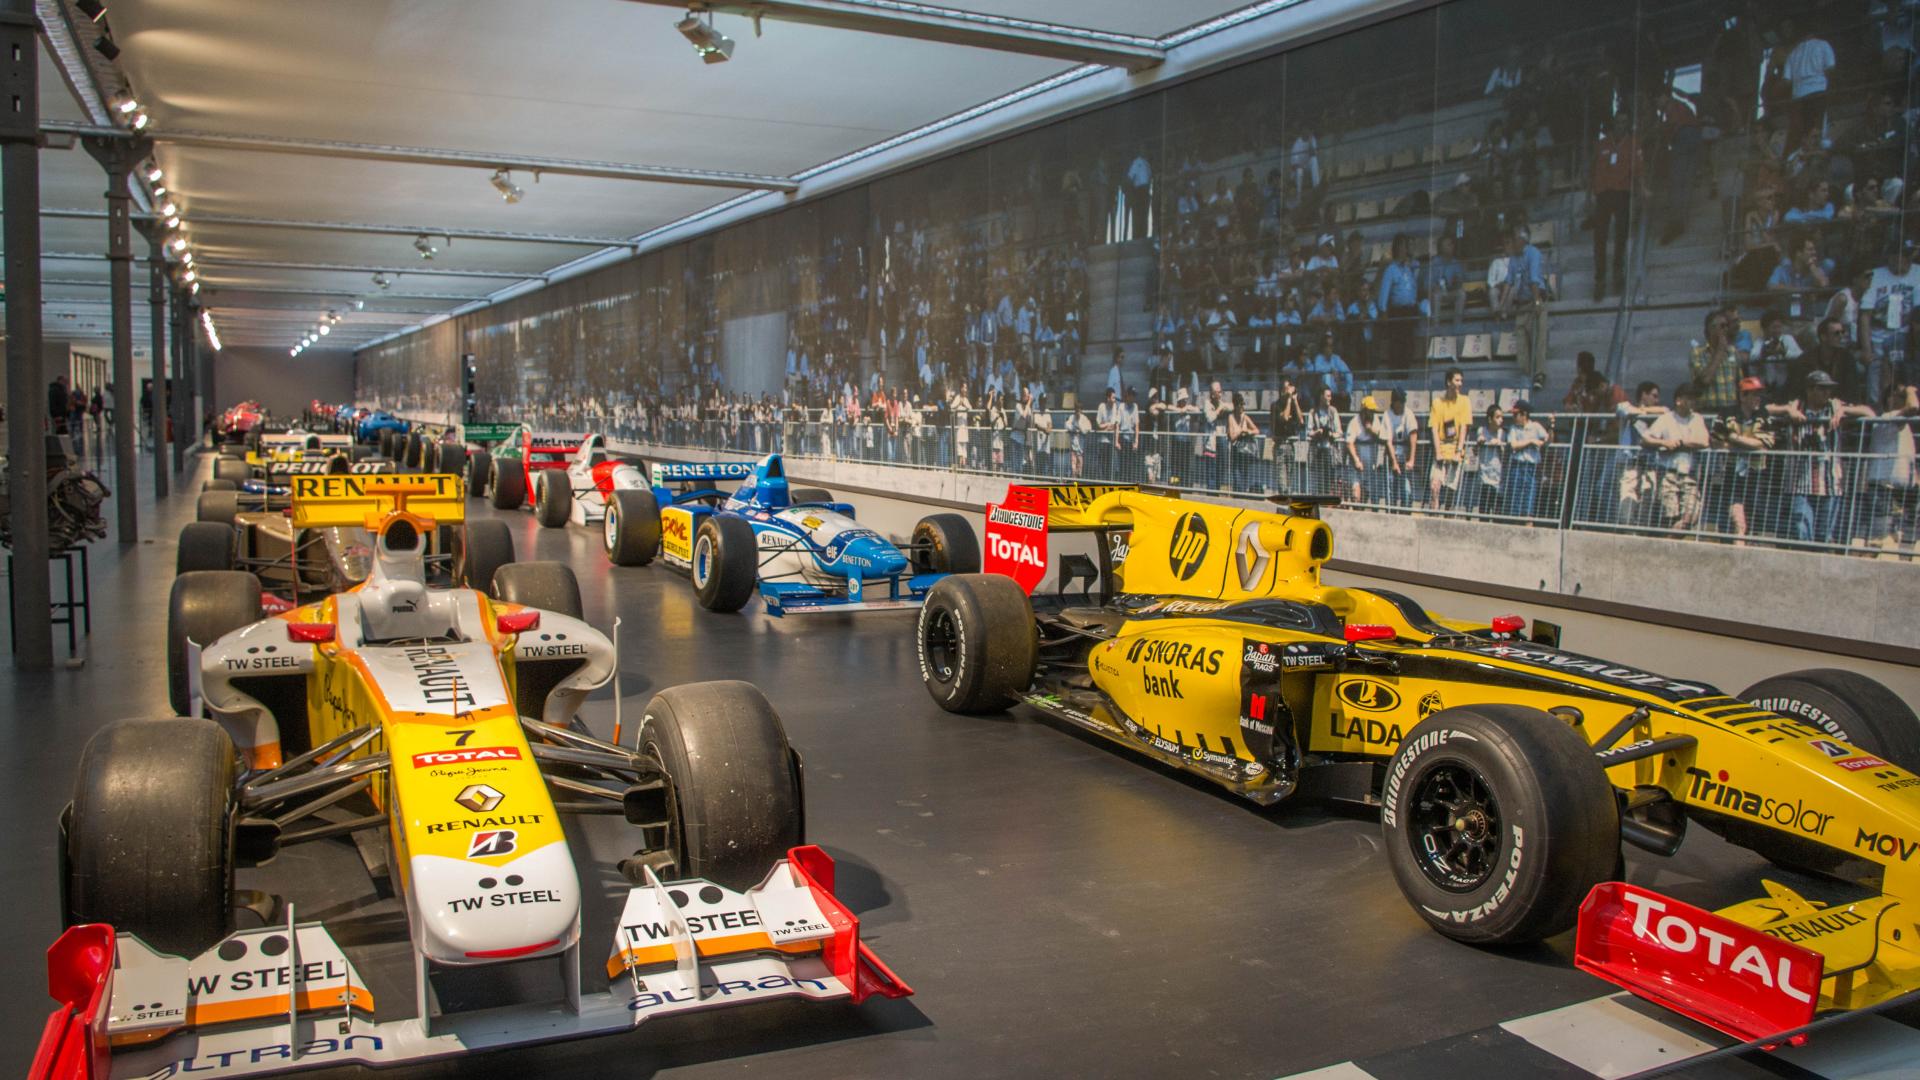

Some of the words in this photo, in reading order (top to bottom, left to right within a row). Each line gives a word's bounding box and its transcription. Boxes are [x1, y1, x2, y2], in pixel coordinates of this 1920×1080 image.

[989, 505, 1044, 530] BRIDGESTONE
[987, 532, 1045, 568] TOTAL
[1171, 512, 1208, 581] hp
[392, 605, 416, 614] PUMA
[523, 646, 543, 657] TW
[547, 644, 588, 656] STEEL
[1144, 640, 1224, 676] SNORAS
[1283, 656, 1297, 666] TW
[1298, 655, 1325, 666] STEEL
[226, 659, 248, 670] TW
[252, 657, 299, 669] STEEL
[1253, 662, 1274, 673] RAGS
[404, 647, 476, 705] RENAULT
[1143, 666, 1185, 700] bank
[1330, 712, 1403, 748] LADA
[1750, 698, 1852, 744] BRIDGESTON
[445, 729, 476, 747] 7
[416, 750, 517, 763] TOTAL
[1203, 751, 1238, 766] Symantec
[1384, 729, 1449, 828] BRIDGESTONE
[427, 814, 544, 834] RENAULT
[1450, 824, 1525, 923] POTENZA
[448, 896, 484, 913] TW
[490, 890, 560, 907] STEEL
[625, 921, 671, 942] TW
[793, 923, 829, 933] STEEL
[1624, 891, 1811, 1004] TOTAL
[187, 974, 221, 997] W
[231, 960, 347, 992] STEEL
[137, 1008, 183, 1019] STEEL
